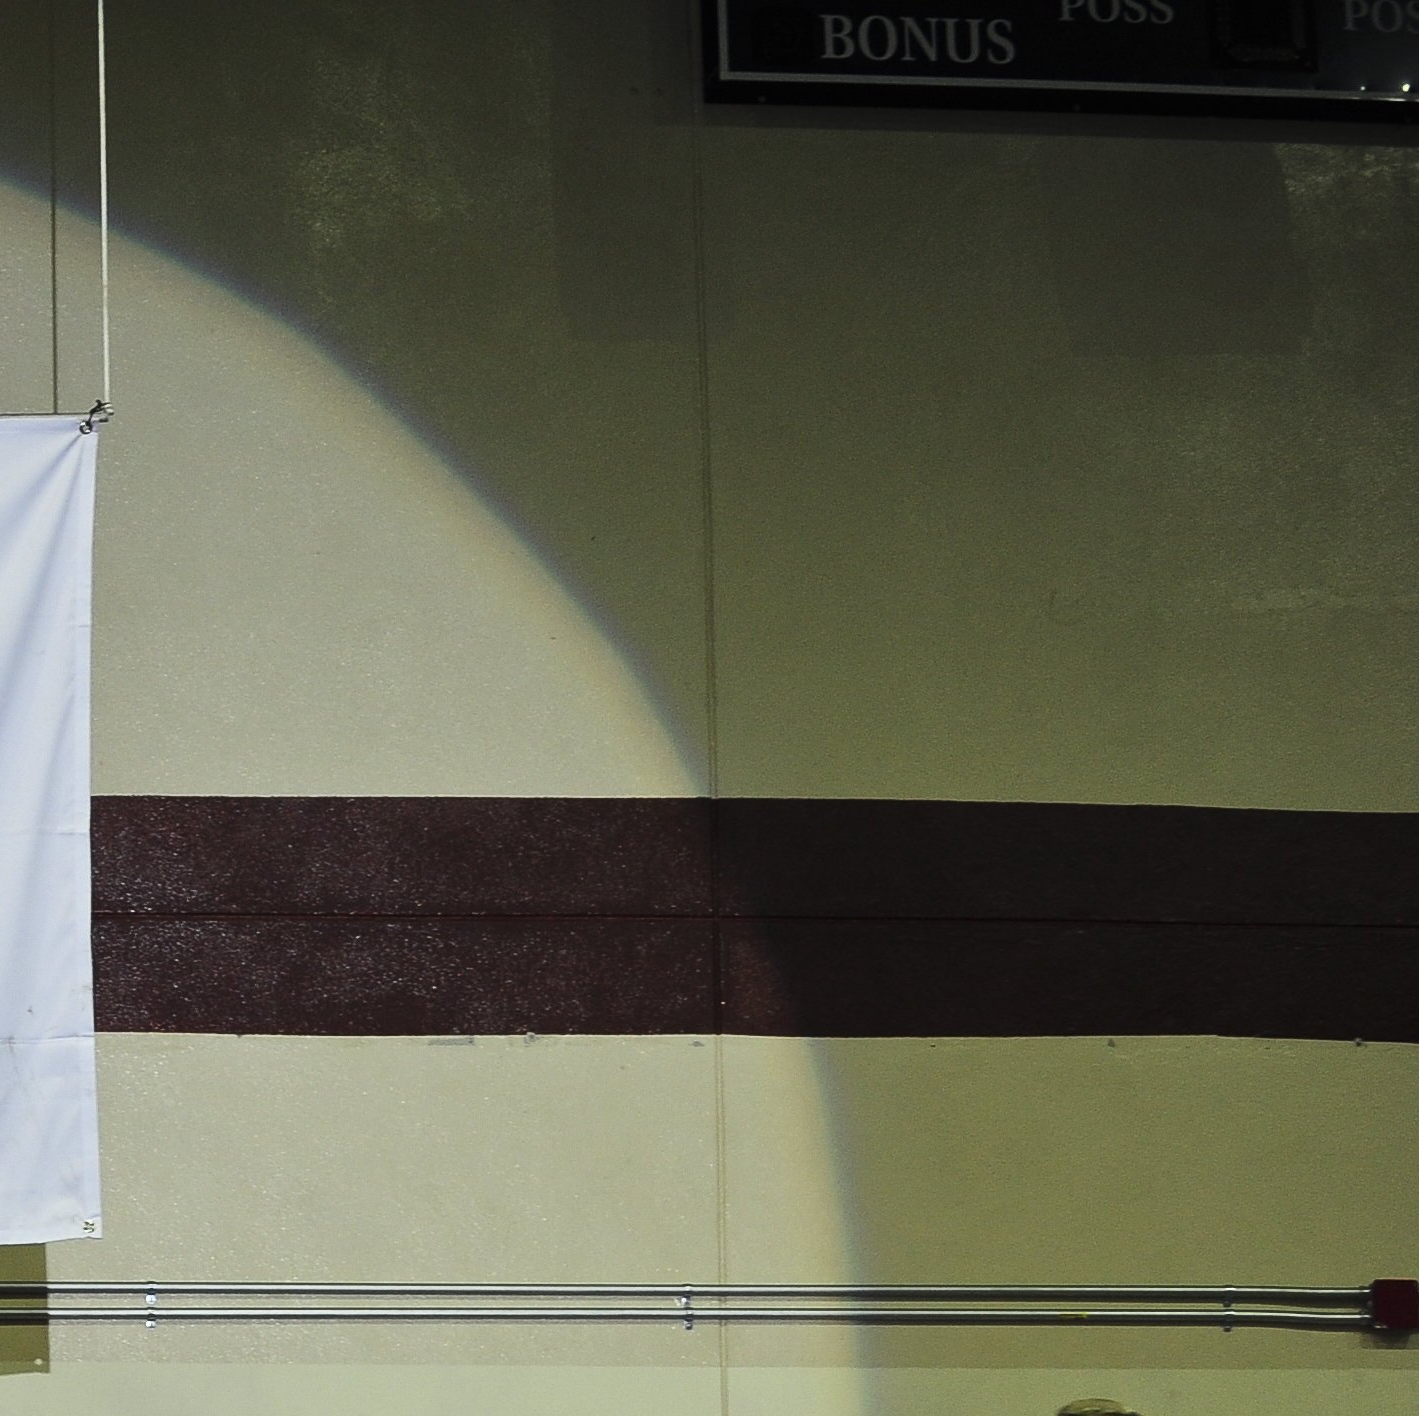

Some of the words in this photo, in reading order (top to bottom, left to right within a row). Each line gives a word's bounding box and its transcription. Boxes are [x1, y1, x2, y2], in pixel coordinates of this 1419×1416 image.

[1059, 0, 1175, 24] POSS
[1343, 0, 1419, 33] POS
[819, 14, 1016, 65] BONUS
